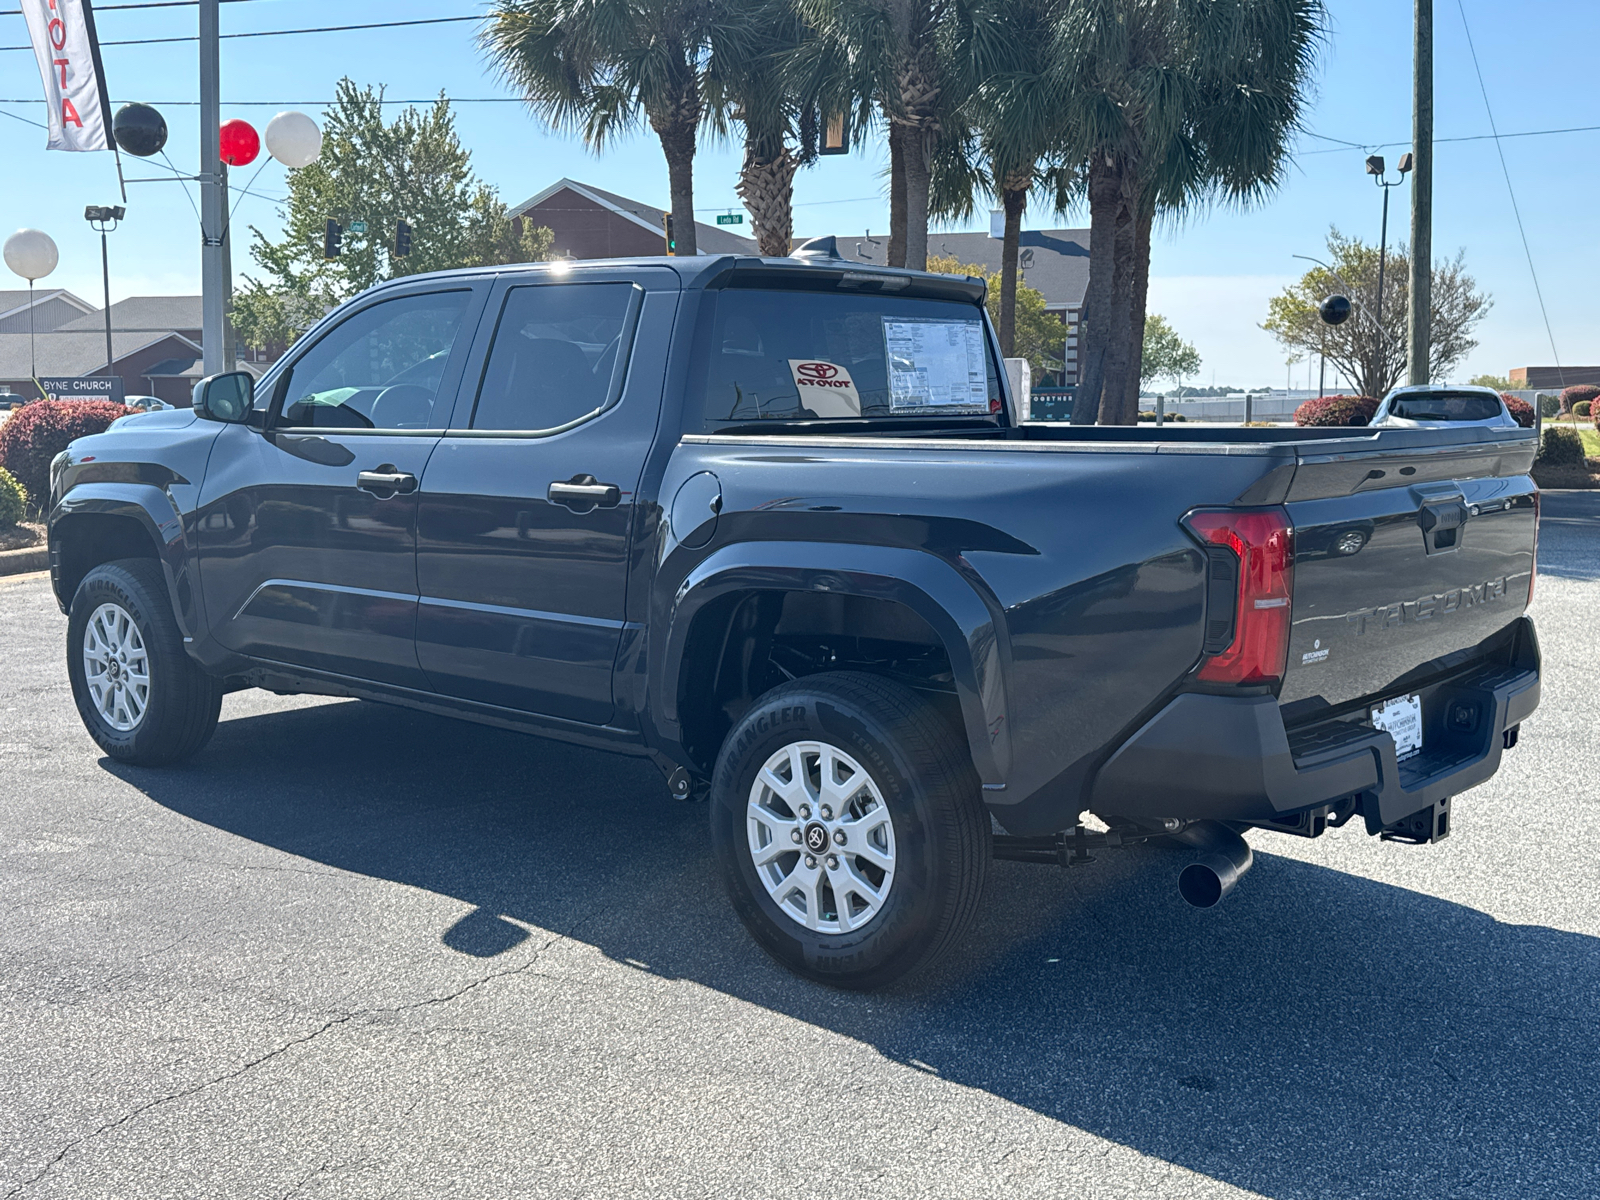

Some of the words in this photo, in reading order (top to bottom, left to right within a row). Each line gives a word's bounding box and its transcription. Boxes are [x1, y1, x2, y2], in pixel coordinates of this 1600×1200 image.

[733, 215, 740, 223] Rd
[43, 381, 68, 390] BYNE
[73, 381, 112, 390] CHURCH
[89, 580, 142, 621] WRANGLER
[1347, 576, 1507, 636] TACOMA
[720, 706, 807, 788] WRANGLER
[851, 730, 905, 802] TERRITORY
